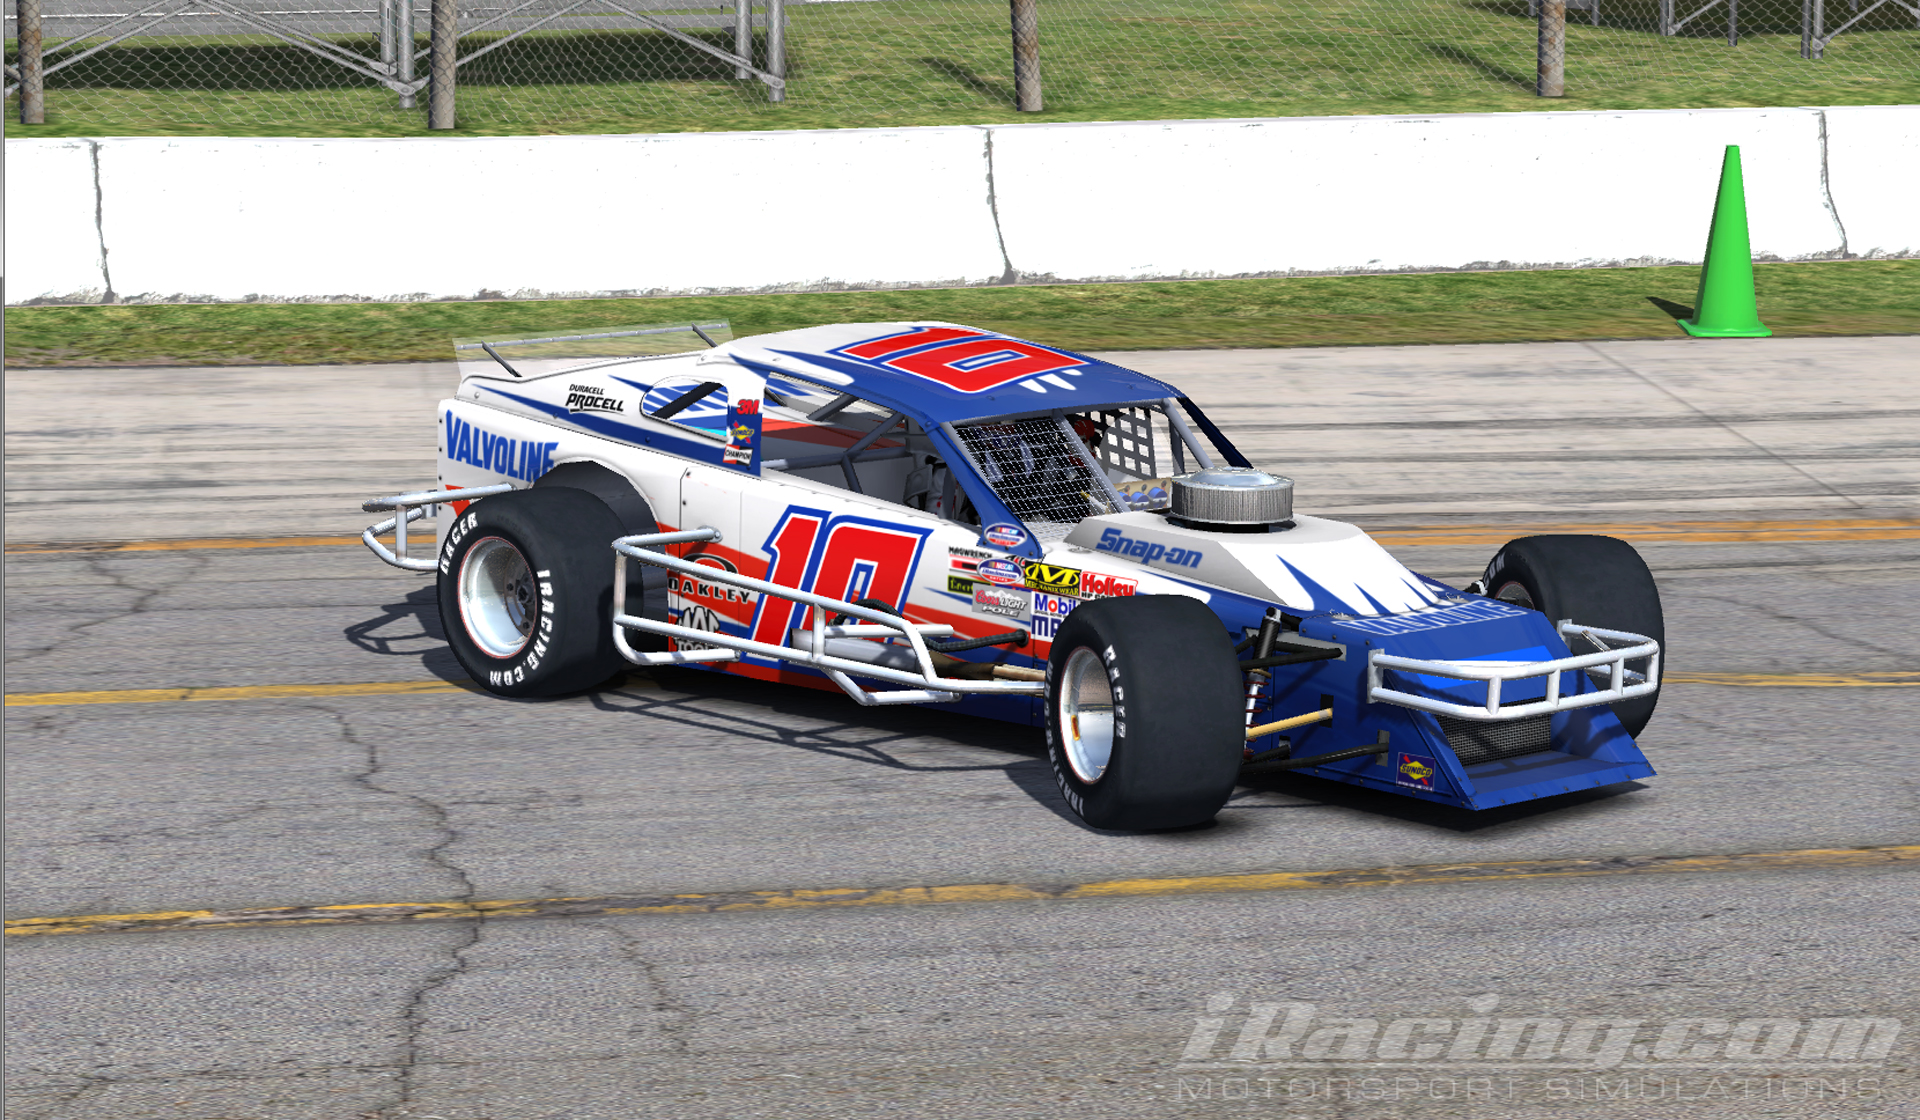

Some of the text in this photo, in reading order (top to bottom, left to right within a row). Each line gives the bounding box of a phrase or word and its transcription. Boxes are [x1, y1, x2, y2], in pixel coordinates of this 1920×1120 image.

[827, 325, 1093, 395] 10
[569, 383, 604, 395] DURACELL
[565, 393, 624, 412] PROCELL
[736, 399, 760, 415] 3M
[446, 409, 559, 482] VALVOLINE
[1096, 527, 1203, 569] Snap-on
[668, 577, 750, 604] OAKLEY
[761, 504, 934, 664] 10
[1081, 573, 1134, 597] Holley
[1034, 593, 1077, 615] Mobil
[1400, 764, 1433, 776] SUNOCO
